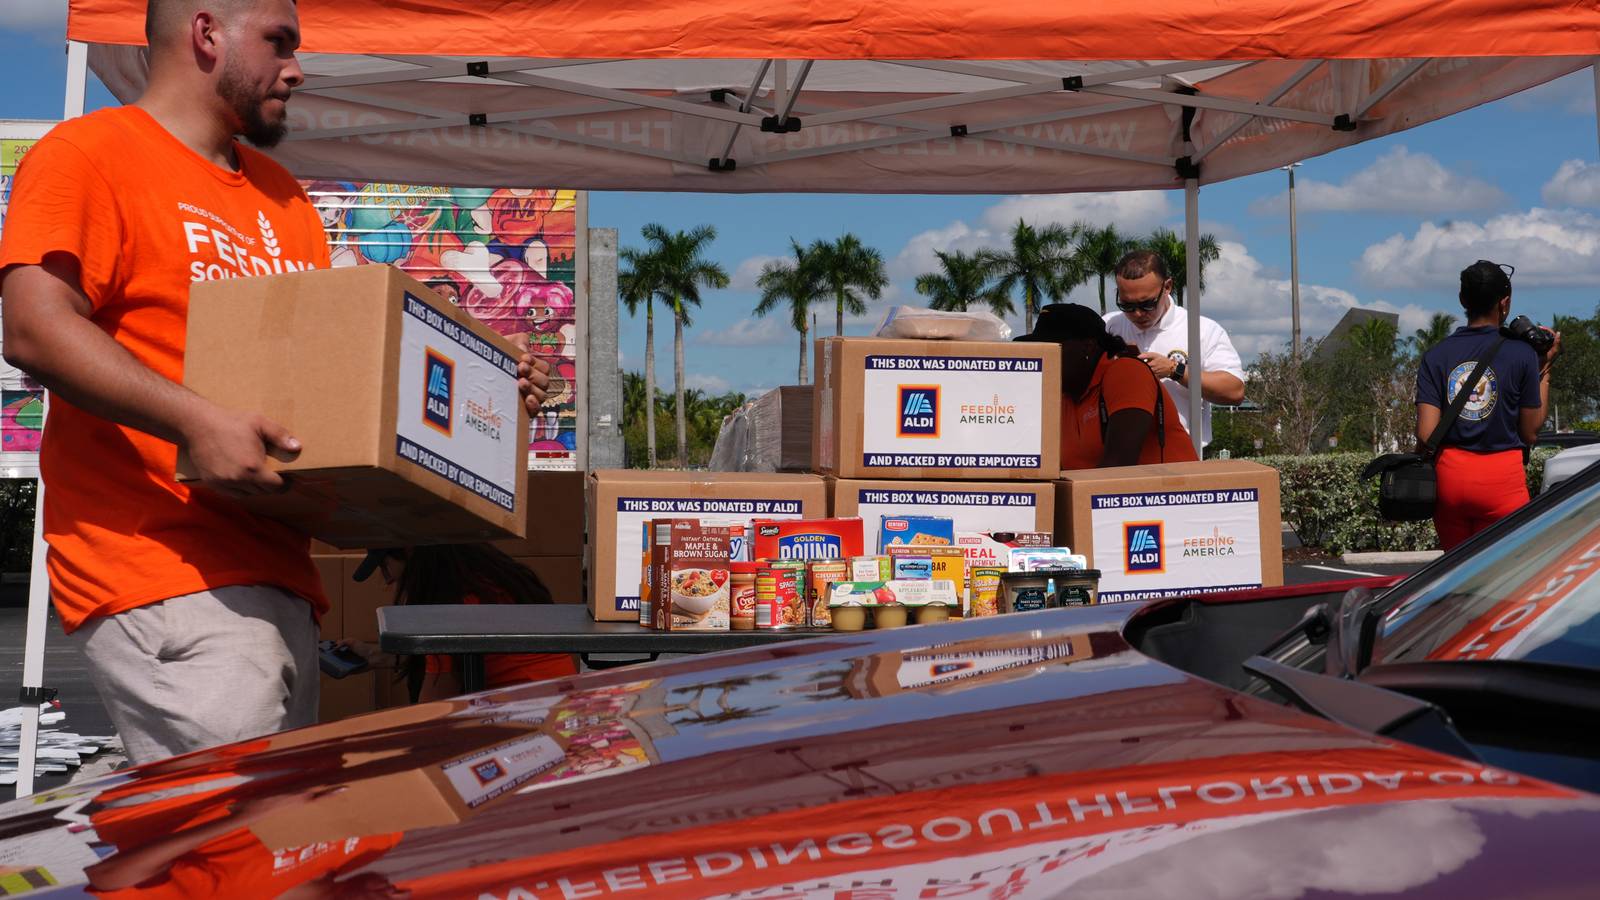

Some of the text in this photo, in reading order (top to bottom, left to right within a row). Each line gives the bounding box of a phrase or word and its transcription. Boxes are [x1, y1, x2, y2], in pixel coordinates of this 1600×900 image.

[408, 298, 518, 377] THIS BOX WAS DONATED BY ALDI
[872, 358, 1038, 371] THIS BOX WAS DONATED BY ALDI
[427, 397, 449, 420] ALDI
[465, 399, 502, 428] FEEDING
[960, 405, 1014, 414] FEEDING
[904, 417, 934, 427] ALDI
[959, 415, 1015, 424] AMERICA
[465, 414, 500, 442] AMERICA
[869, 455, 1037, 467] AND PACKED BY OUR EMPLOYEES
[400, 441, 513, 509] AND PACKED BY OUR EMPLOYEES
[865, 493, 1032, 506] THIS BOX WAS DONATED BY ALDI
[1097, 491, 1254, 508] THIS BOX WAS DONATED BY ALDI
[624, 500, 798, 513] THIS BOX WAS DONATED BY ALDI
[793, 535, 826, 543] GOLDEN
[1183, 537, 1234, 548] FEEDING
[1183, 547, 1235, 557] AMERICA
[1130, 553, 1158, 564] ALDI
[931, 561, 947, 571] BAR
[1100, 593, 1123, 604] AND
